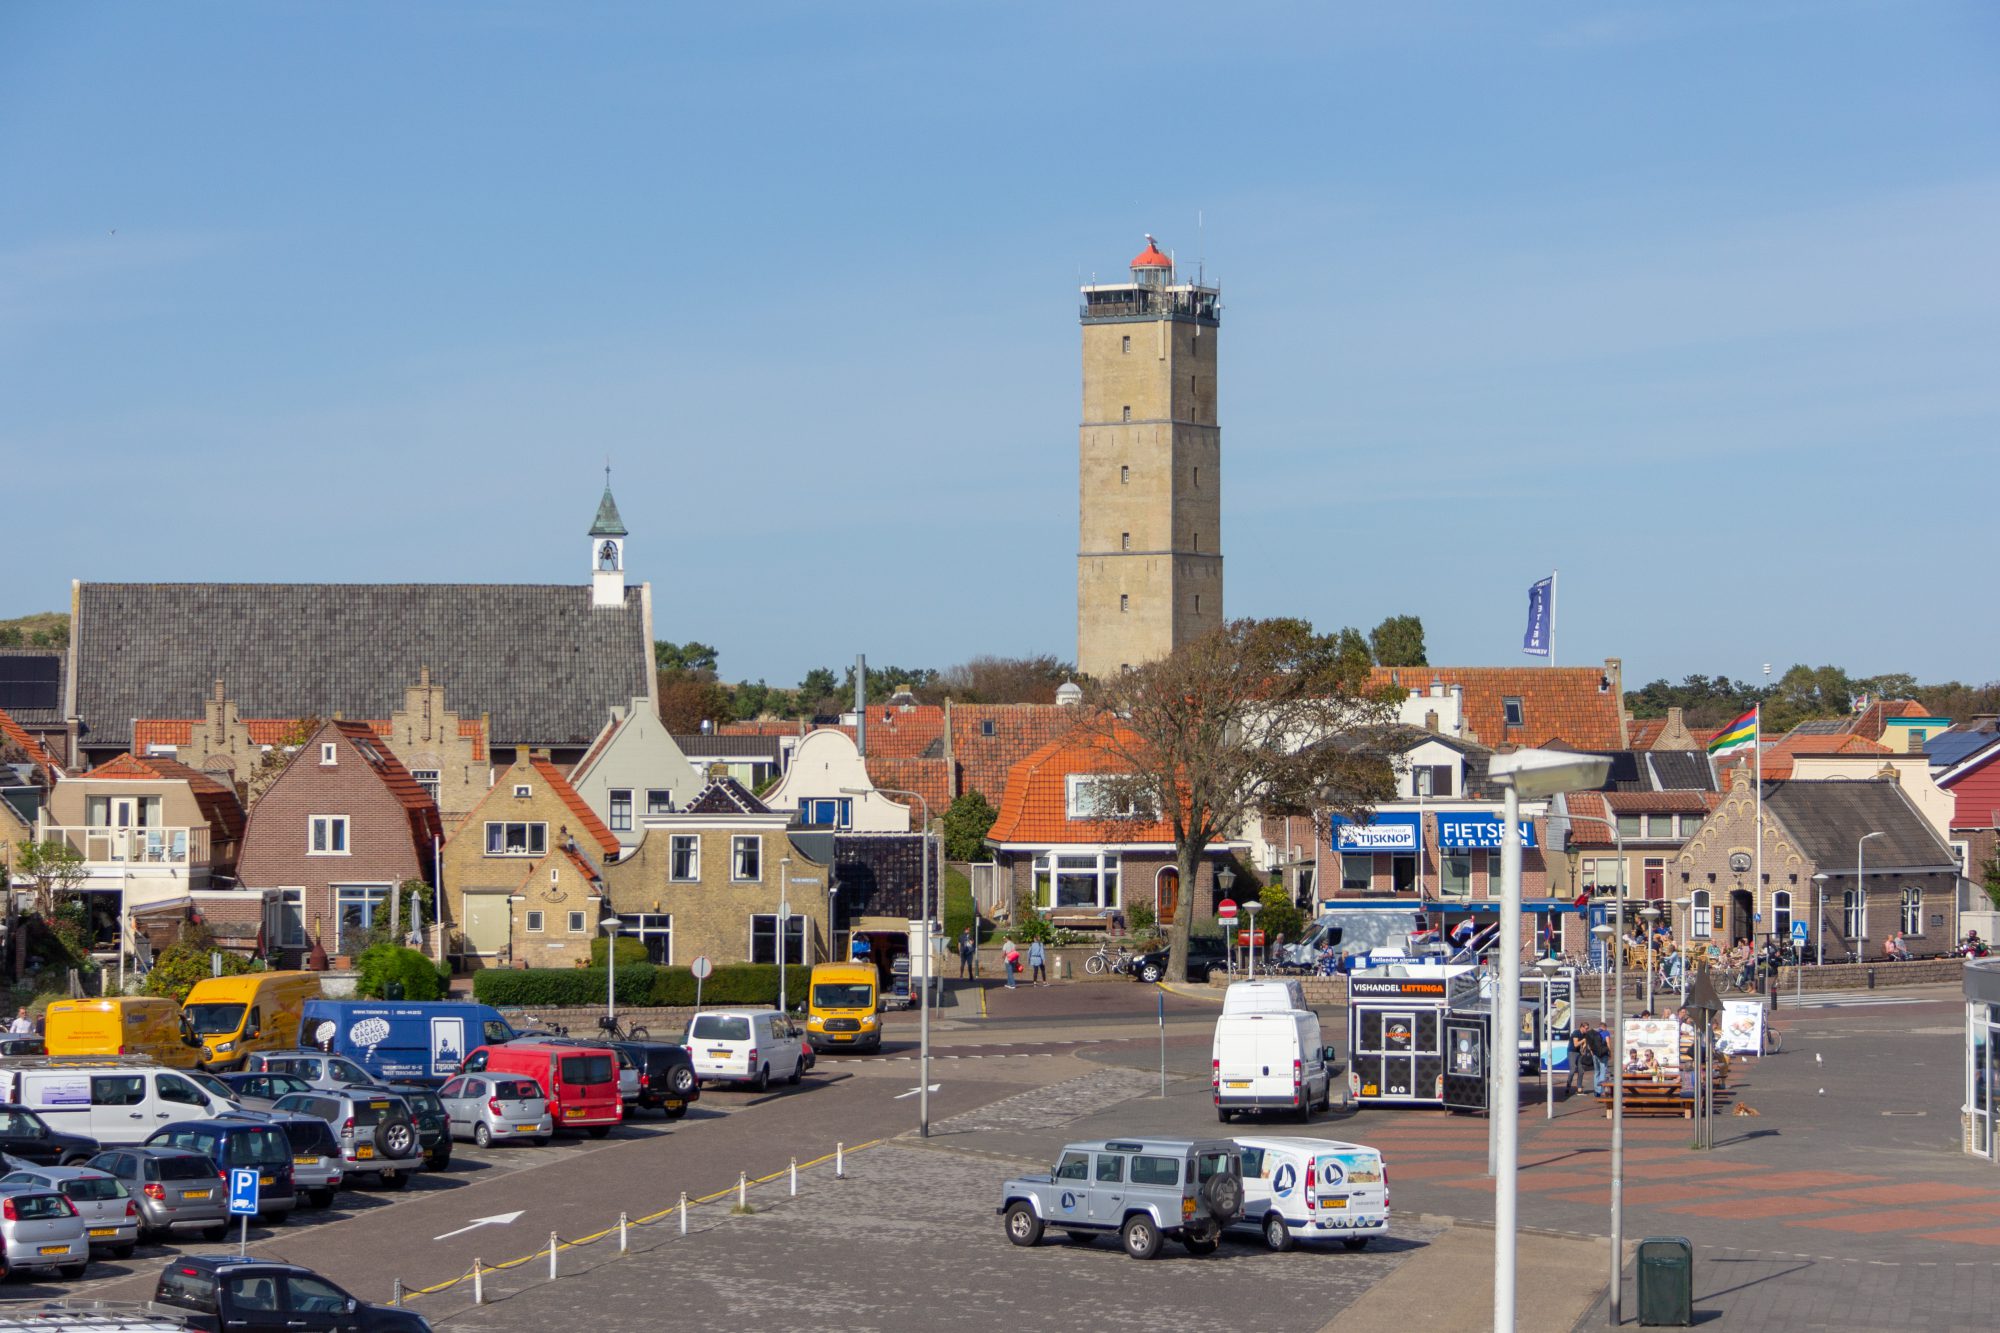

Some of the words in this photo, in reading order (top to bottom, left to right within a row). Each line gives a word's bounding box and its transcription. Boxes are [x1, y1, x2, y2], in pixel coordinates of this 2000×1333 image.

[1360, 833, 1411, 845] TIJSKNOP
[1353, 984, 1400, 992] VISHANDEL
[354, 1019, 381, 1031] GRATIS
[354, 1024, 384, 1040] BAGAGE
[237, 1172, 253, 1195] P
